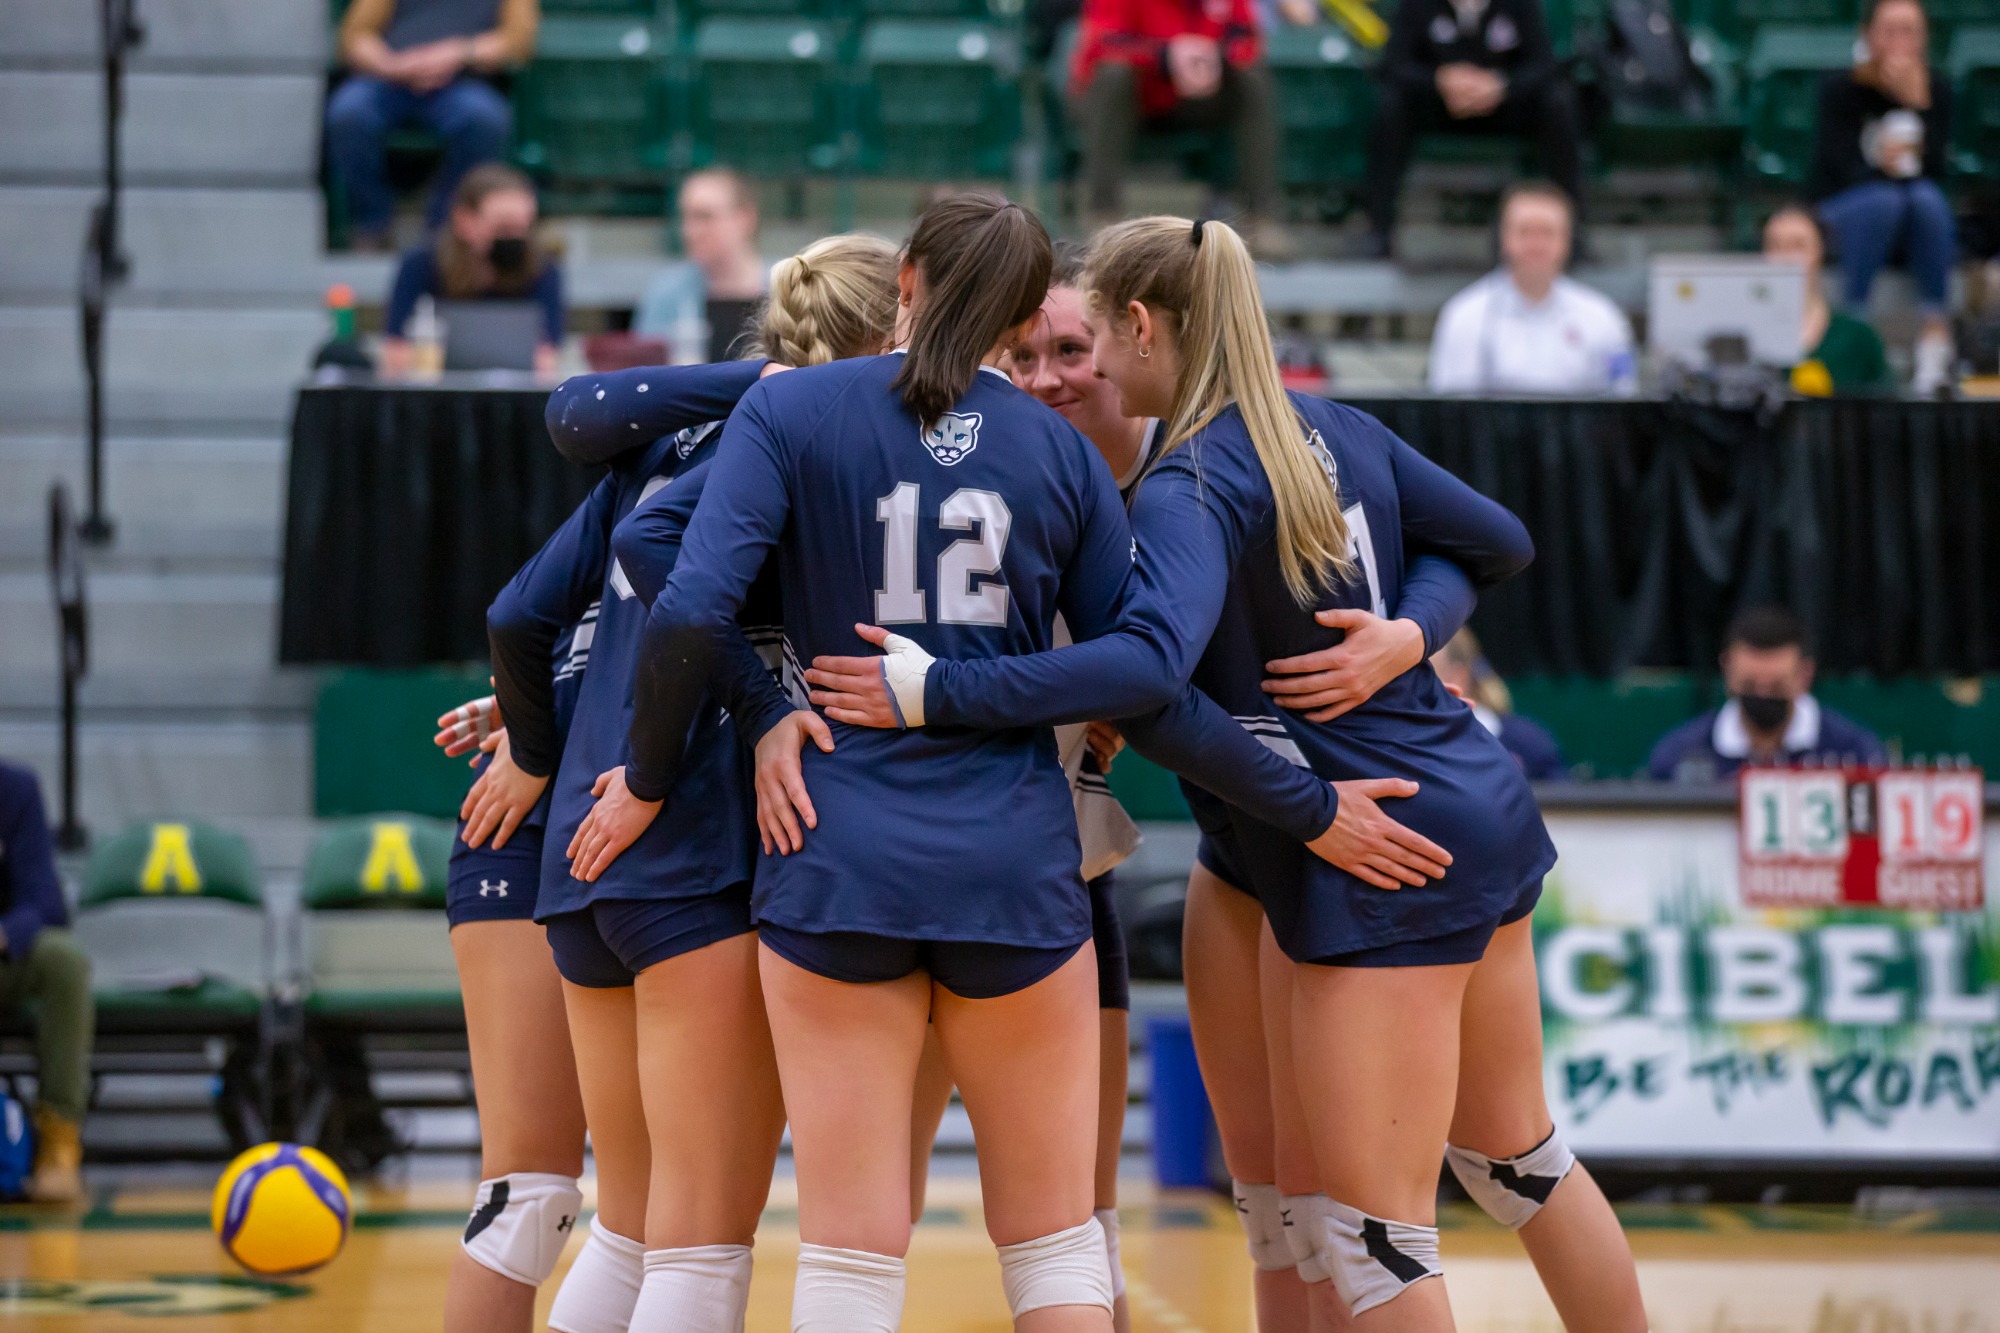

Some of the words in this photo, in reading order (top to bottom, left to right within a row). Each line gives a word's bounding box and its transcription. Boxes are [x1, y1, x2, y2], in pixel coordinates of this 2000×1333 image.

[875, 482, 1013, 628] 12
[1760, 790, 1840, 855] 13
[1895, 791, 1973, 855] 19
[1542, 925, 1999, 1024] CIBEL
